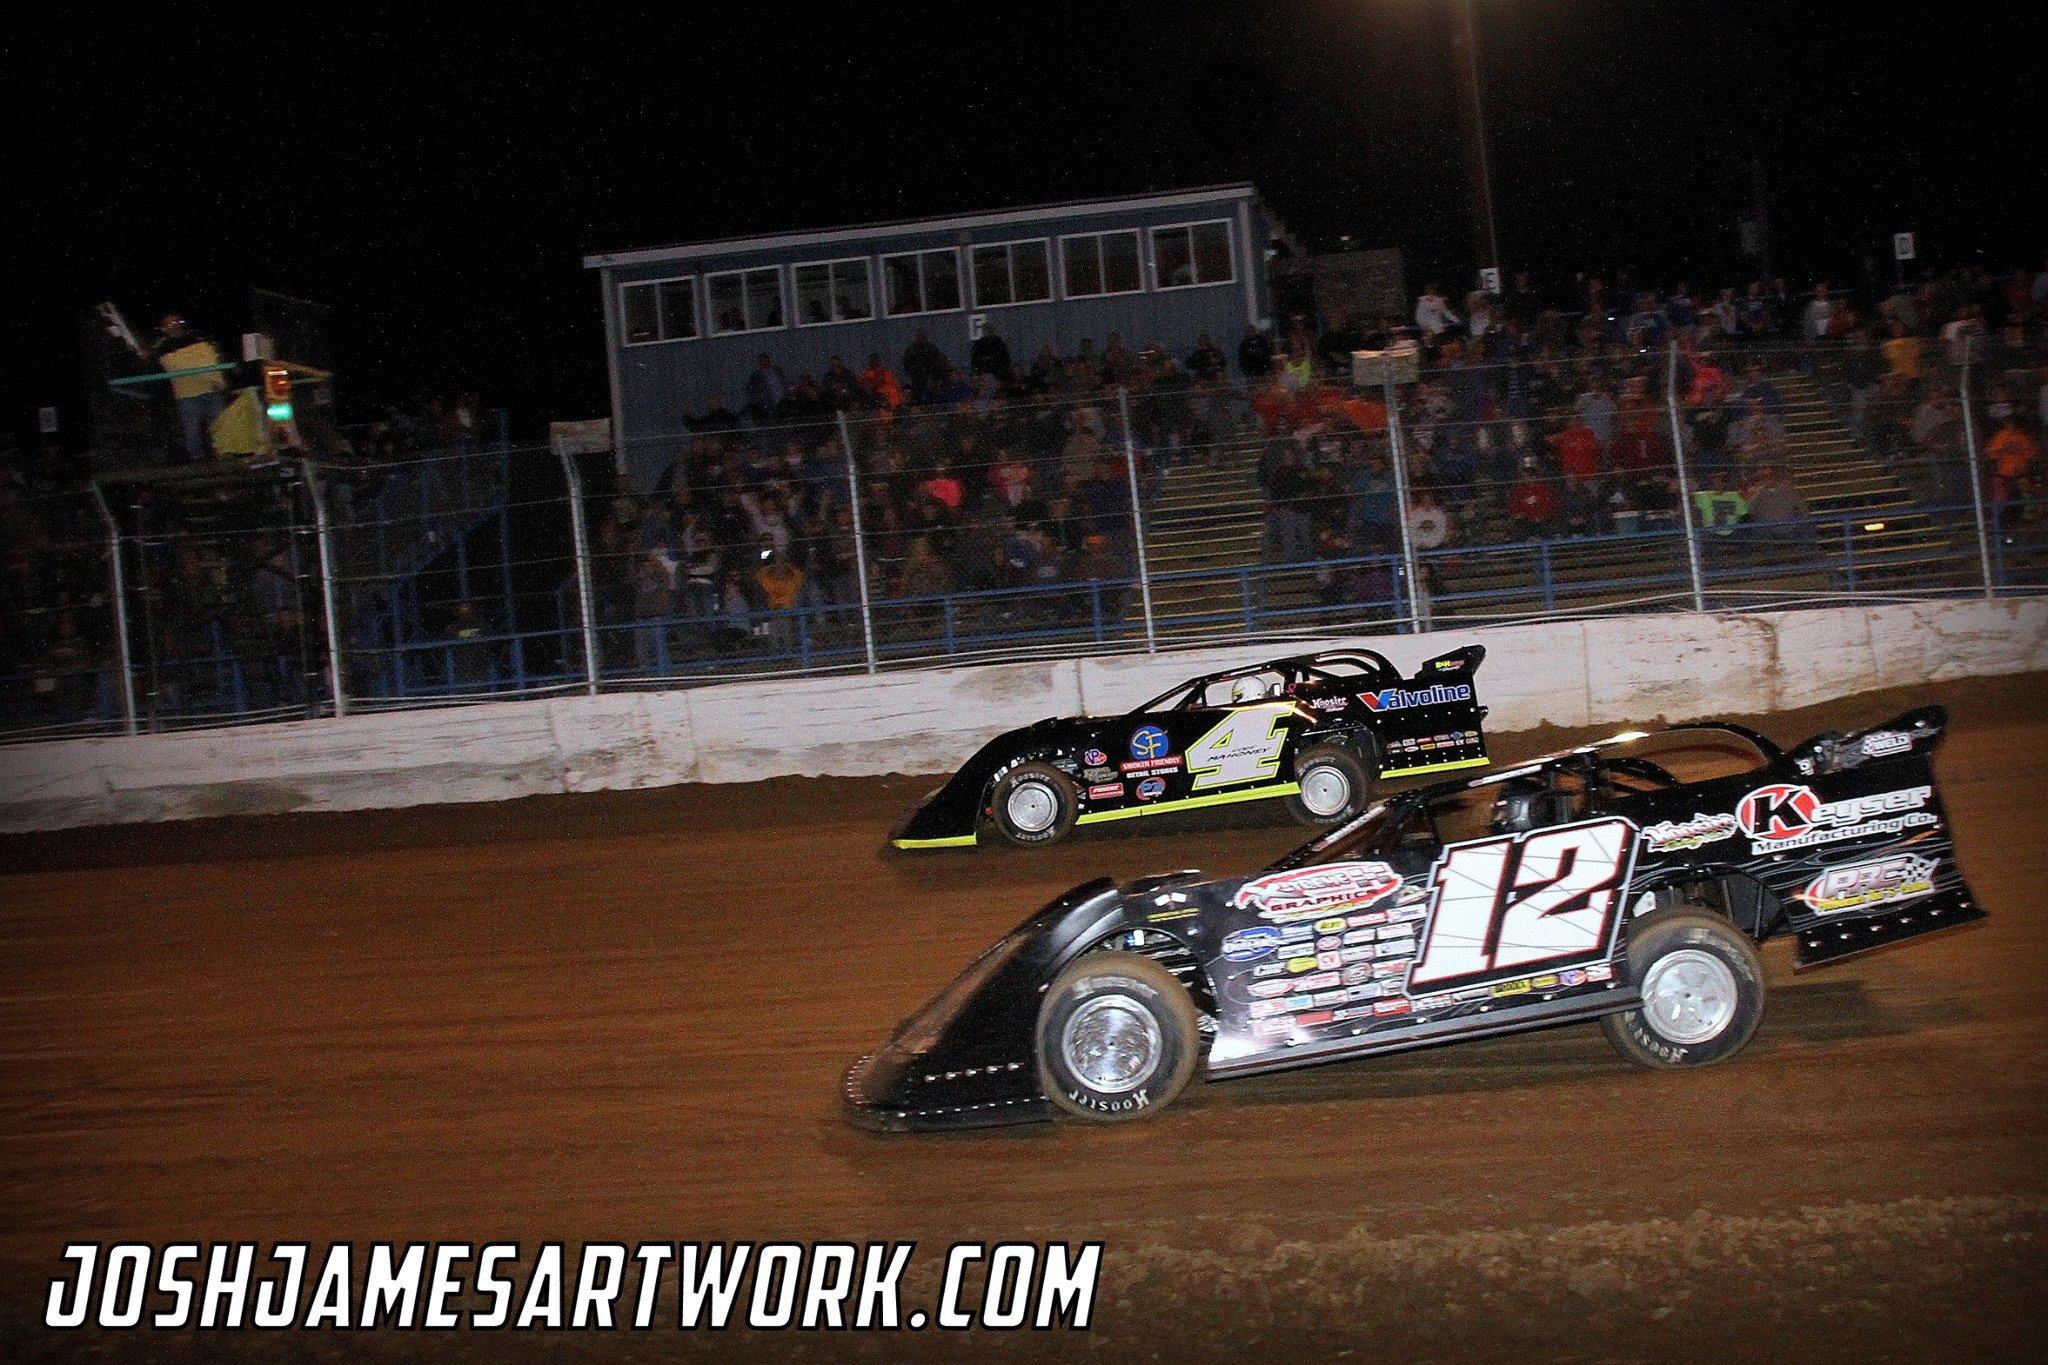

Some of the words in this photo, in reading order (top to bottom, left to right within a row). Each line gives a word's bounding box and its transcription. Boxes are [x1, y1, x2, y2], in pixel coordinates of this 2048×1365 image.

[1356, 684, 1470, 712] Valvoline
[1132, 730, 1163, 759] SF
[1184, 700, 1297, 791] 4
[1207, 747, 1272, 762] MAHONEY
[1122, 761, 1150, 771] SMOKER
[1151, 756, 1182, 767] FRIENDLY
[1743, 784, 1932, 839] Keyser
[1756, 819, 1900, 853] Manufacturing
[1905, 813, 1936, 826] Co.
[1270, 888, 1380, 912] GRAPHICS
[1409, 820, 1629, 987] 12
[1068, 1088, 1150, 1112] Hoosier
